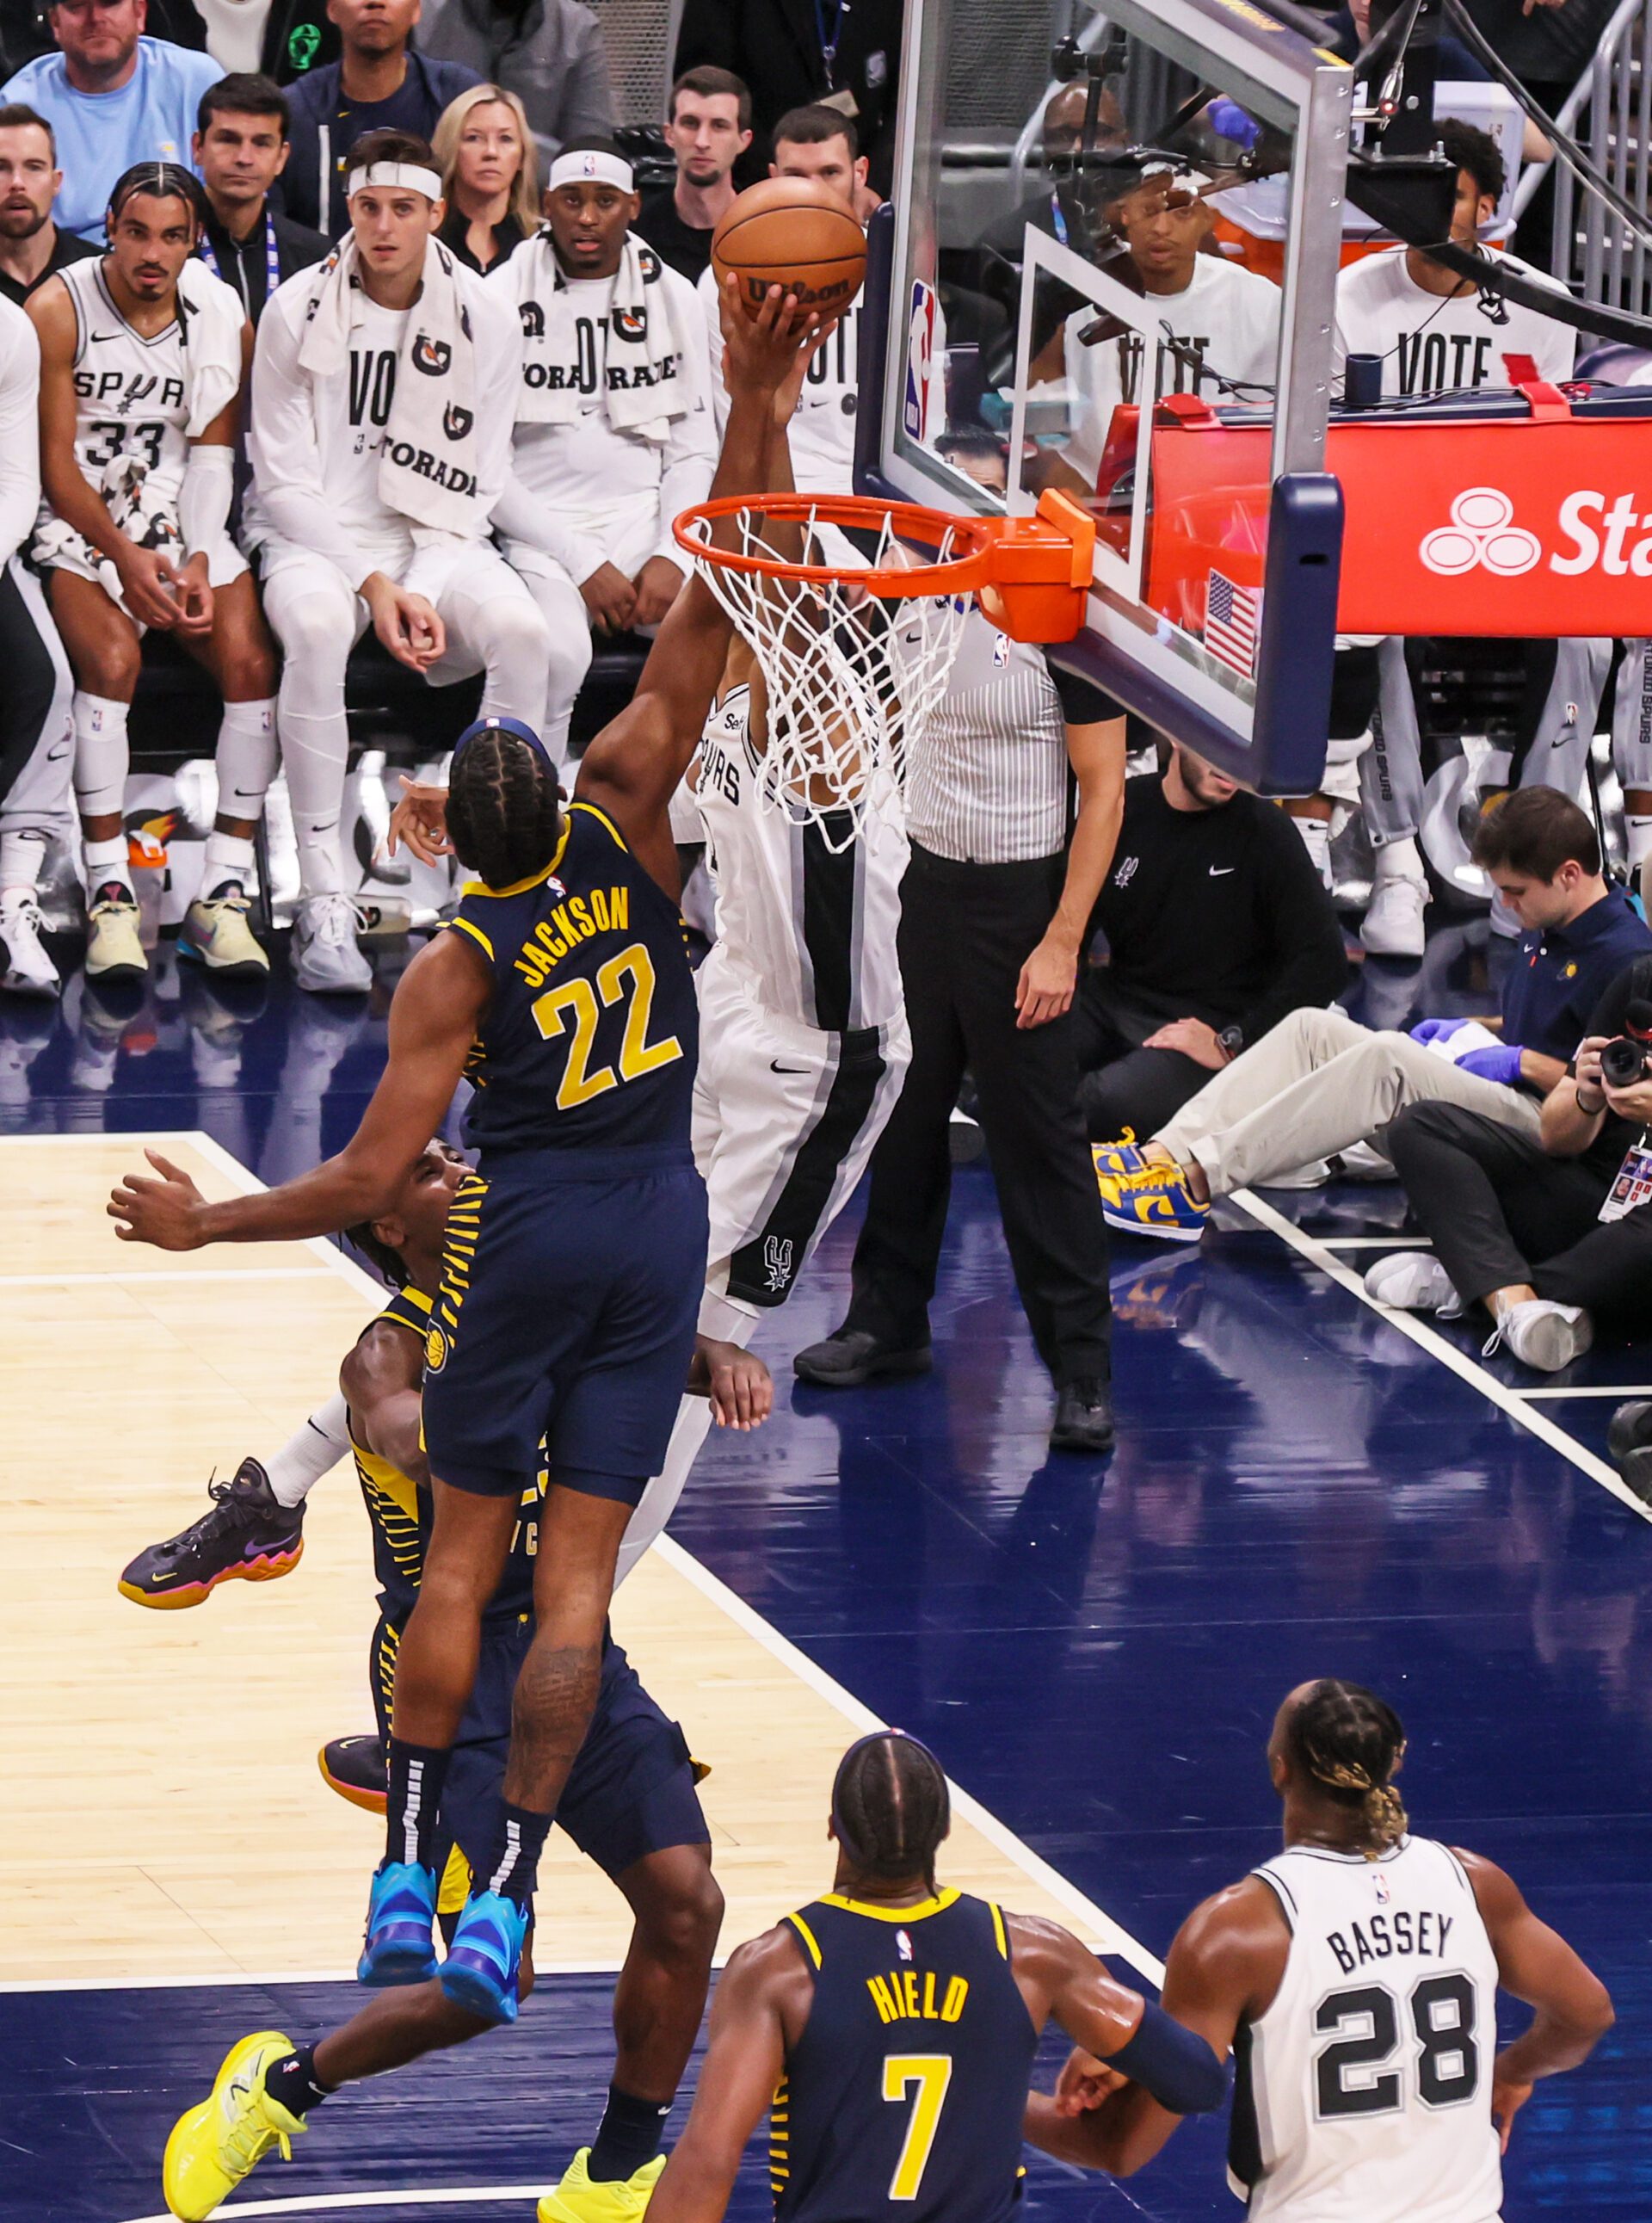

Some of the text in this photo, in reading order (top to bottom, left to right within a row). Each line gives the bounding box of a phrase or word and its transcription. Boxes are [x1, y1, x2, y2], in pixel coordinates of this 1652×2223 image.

[73, 372, 188, 416] SPUR
[522, 364, 582, 389] ORA
[1398, 332, 1492, 398] VOTE
[87, 422, 165, 471] 33
[514, 886, 628, 988] JACKSON
[531, 942, 684, 1110] 22
[1326, 1911, 1453, 1975] BASSEY
[866, 1971, 970, 2024] HIELD
[1310, 1967, 1481, 2123] 28
[882, 2054, 952, 2201] 7
